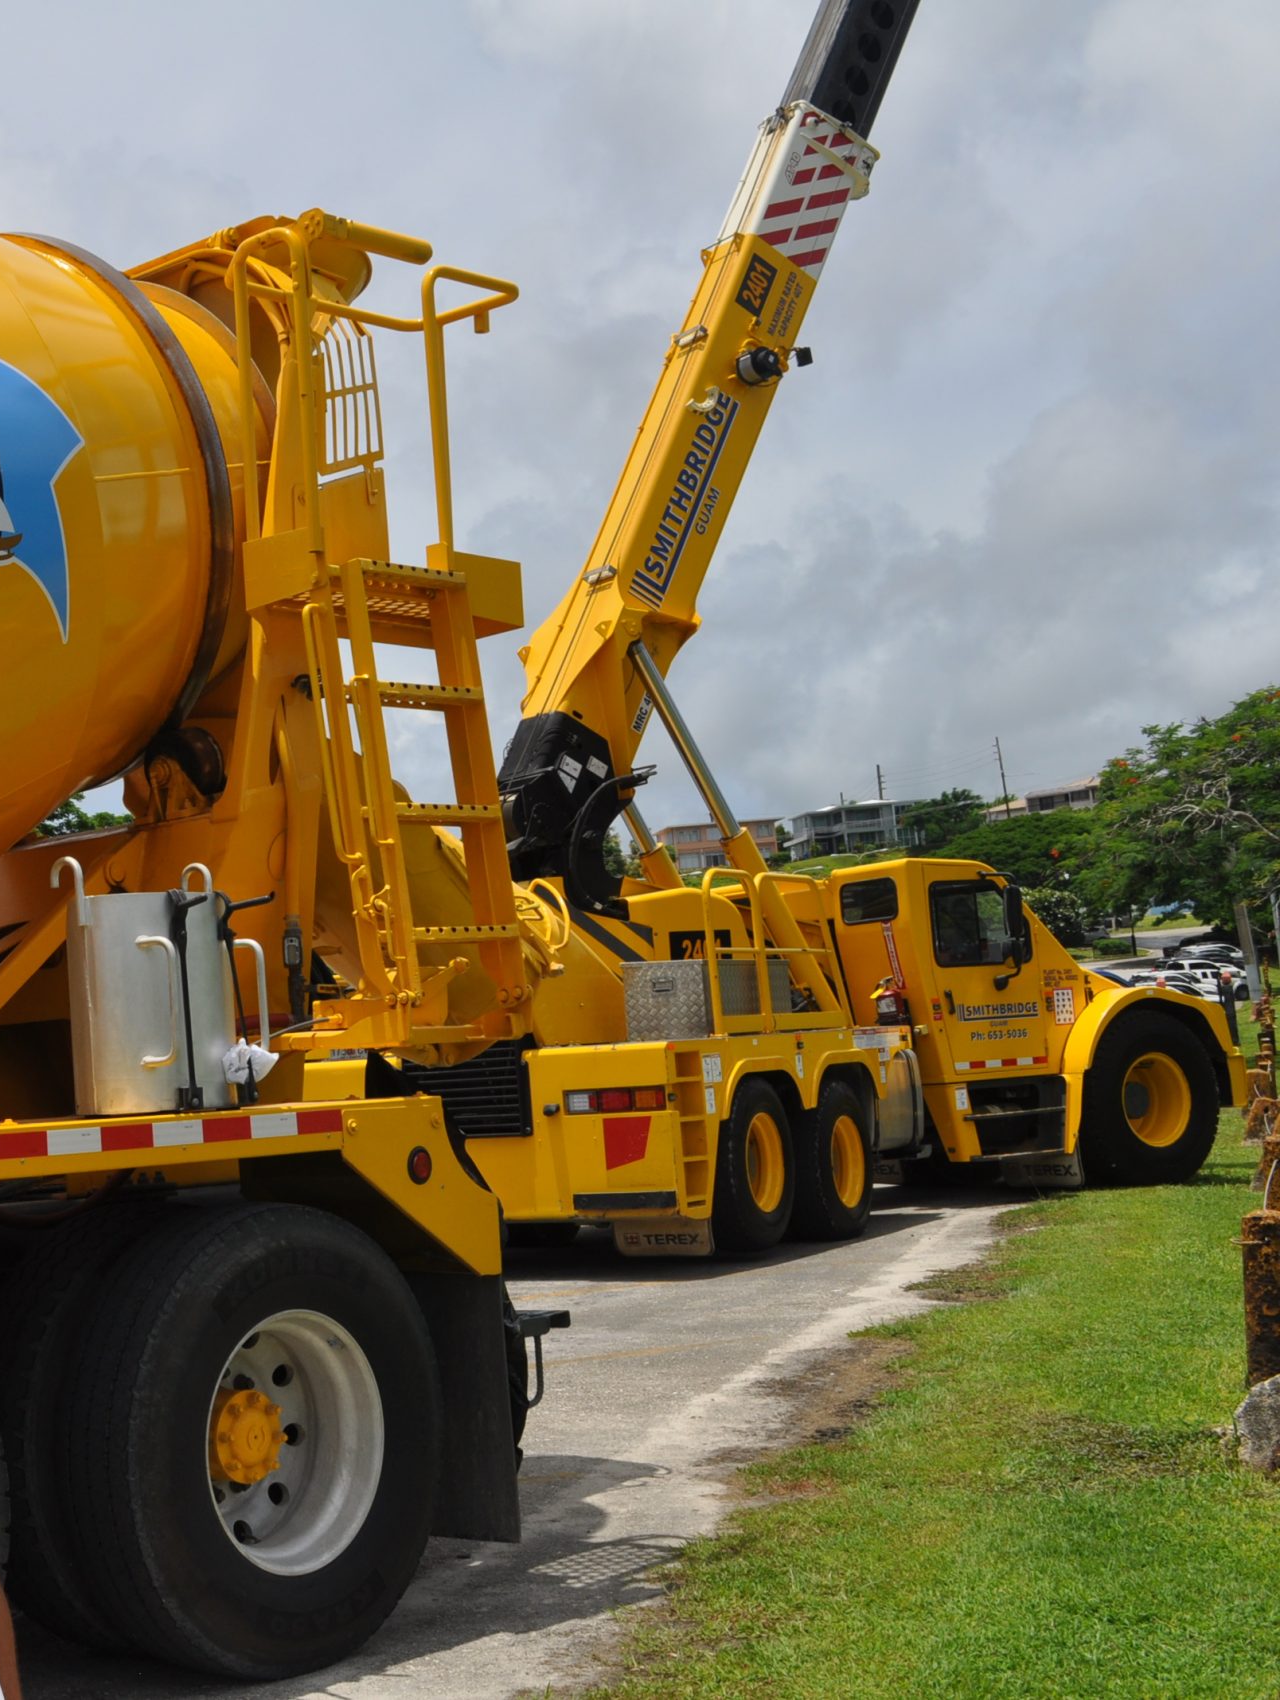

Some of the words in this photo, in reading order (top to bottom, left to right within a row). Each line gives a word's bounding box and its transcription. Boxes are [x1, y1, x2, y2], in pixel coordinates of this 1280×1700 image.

[741, 261, 772, 309] 2401
[767, 296, 788, 336] MAXIMUM
[782, 271, 797, 297] RATED
[777, 299, 798, 337] CAPACITY
[643, 390, 733, 579] SMITHBRIDGE
[694, 487, 721, 536] GUAM
[633, 706, 649, 732] MRC
[965, 1001, 1038, 1017] SMITHBRIDGE
[971, 1031, 985, 1041] Ph:
[987, 1028, 1028, 1040] 653-5036
[1023, 1164, 1074, 1177] TEREX
[642, 1232, 699, 1246] TEREX
